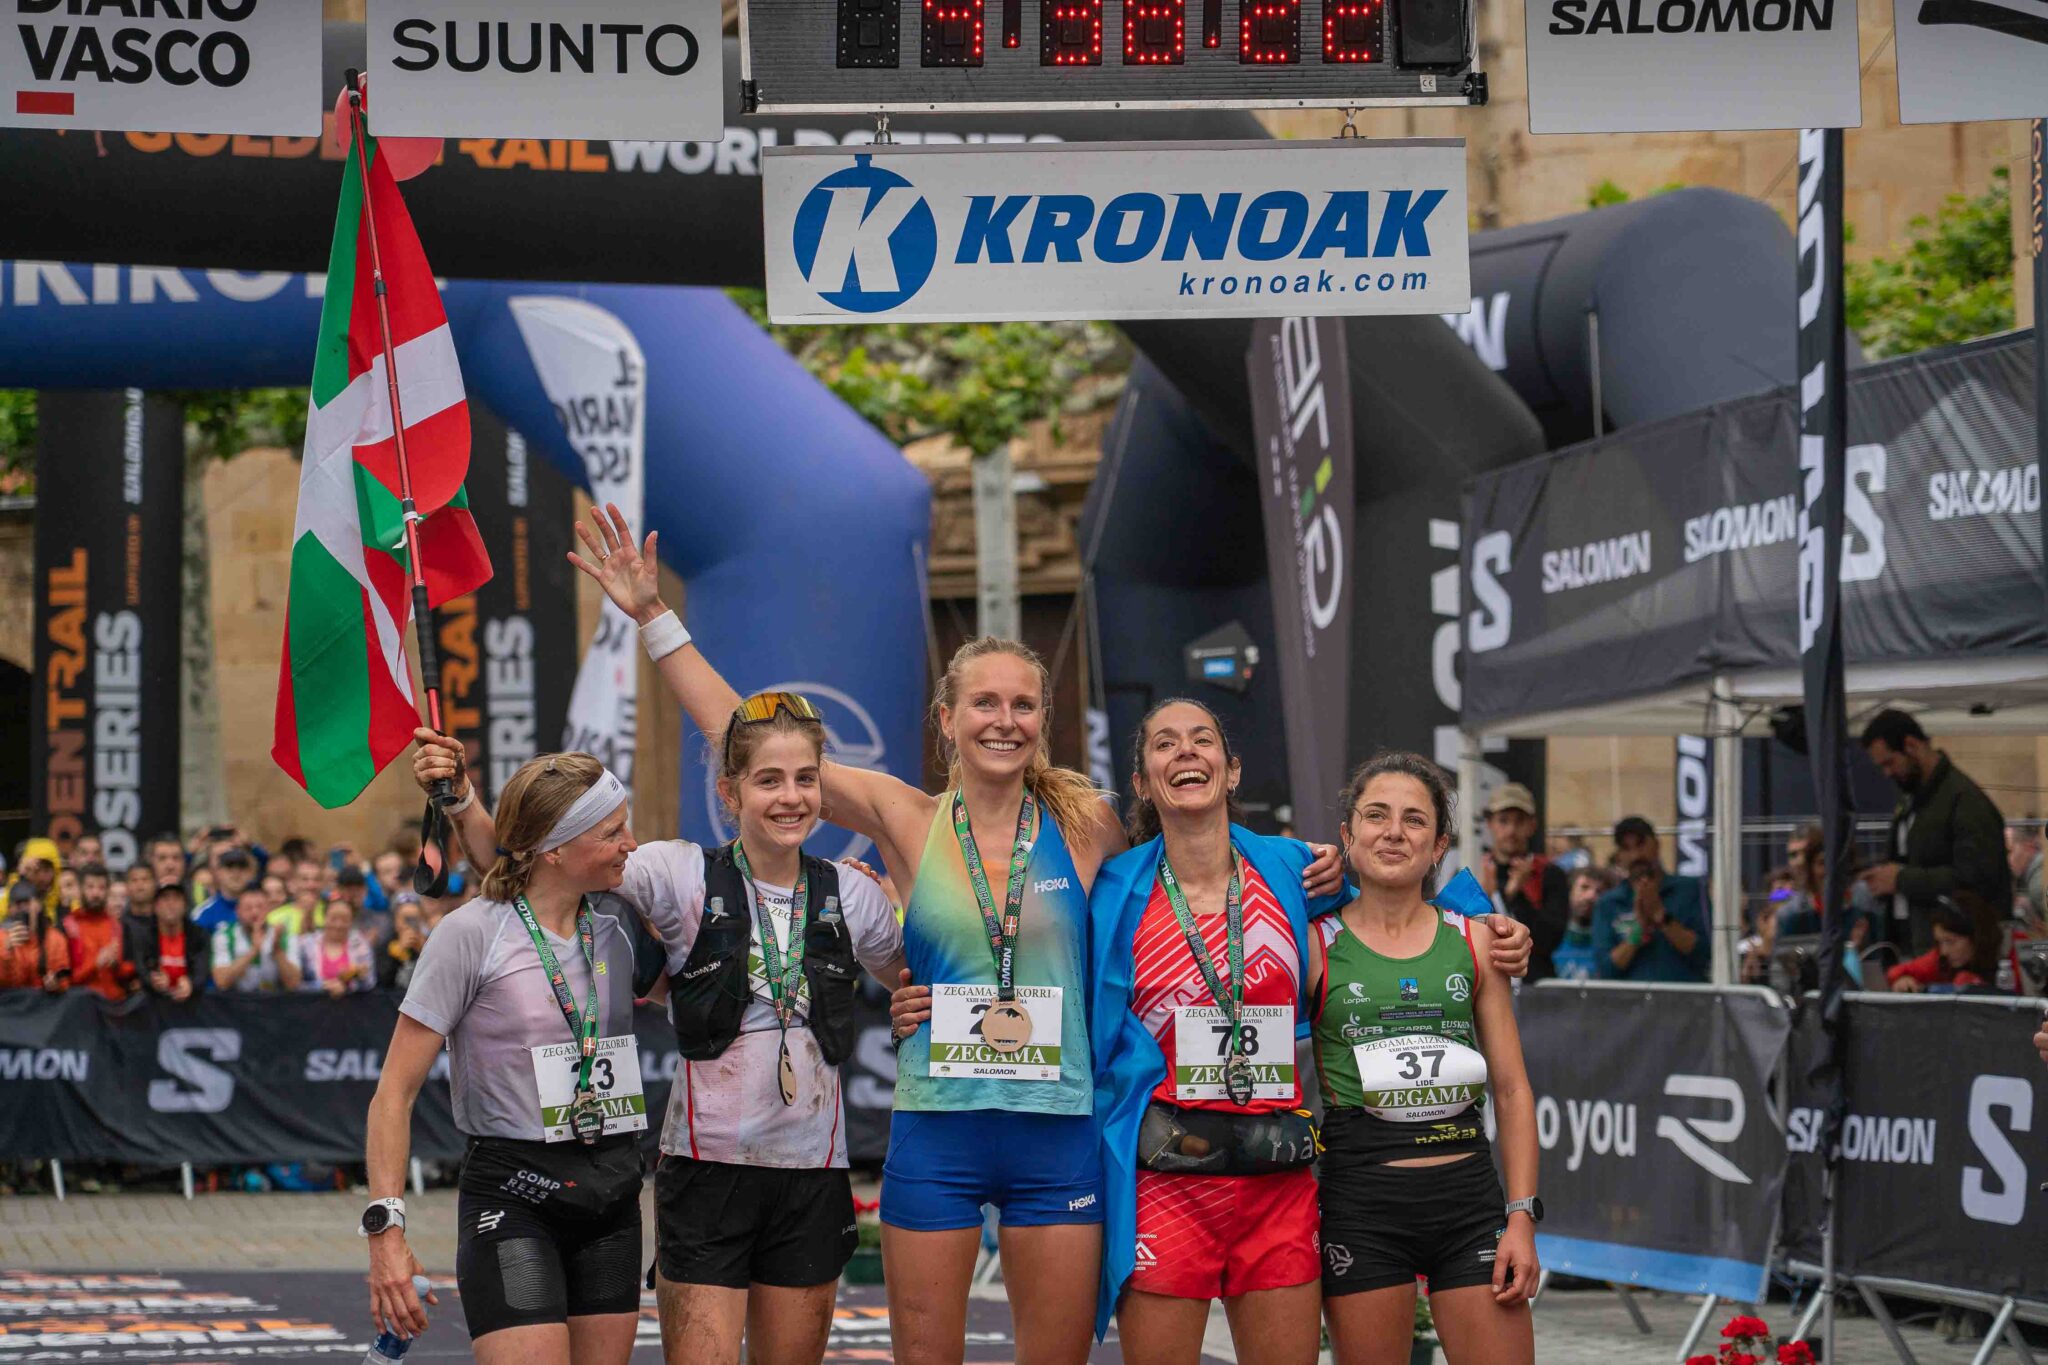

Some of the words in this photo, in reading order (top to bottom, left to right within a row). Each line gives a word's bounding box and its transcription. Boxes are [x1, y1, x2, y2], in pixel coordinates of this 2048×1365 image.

[1549, 0, 1834, 35] SALOMON
[16, 26, 250, 88] VASCO
[392, 19, 700, 76] SUUNTO
[954, 189, 1450, 265] KRONOAK
[1179, 270, 1428, 297] kronoak.com
[1541, 530, 1652, 594] SALOMON
[1034, 877, 1070, 894] HOKA
[1211, 1025, 1260, 1057] 78
[973, 1067, 1017, 1076] SALOMON
[1396, 1050, 1446, 1080] 37
[1377, 1086, 1471, 1107] ZEGAMA
[1405, 1109, 1446, 1119] SALOMON
[1566, 1100, 1637, 1171] you
[517, 1169, 560, 1191] COMP
[1068, 1193, 1097, 1211] HOKA
